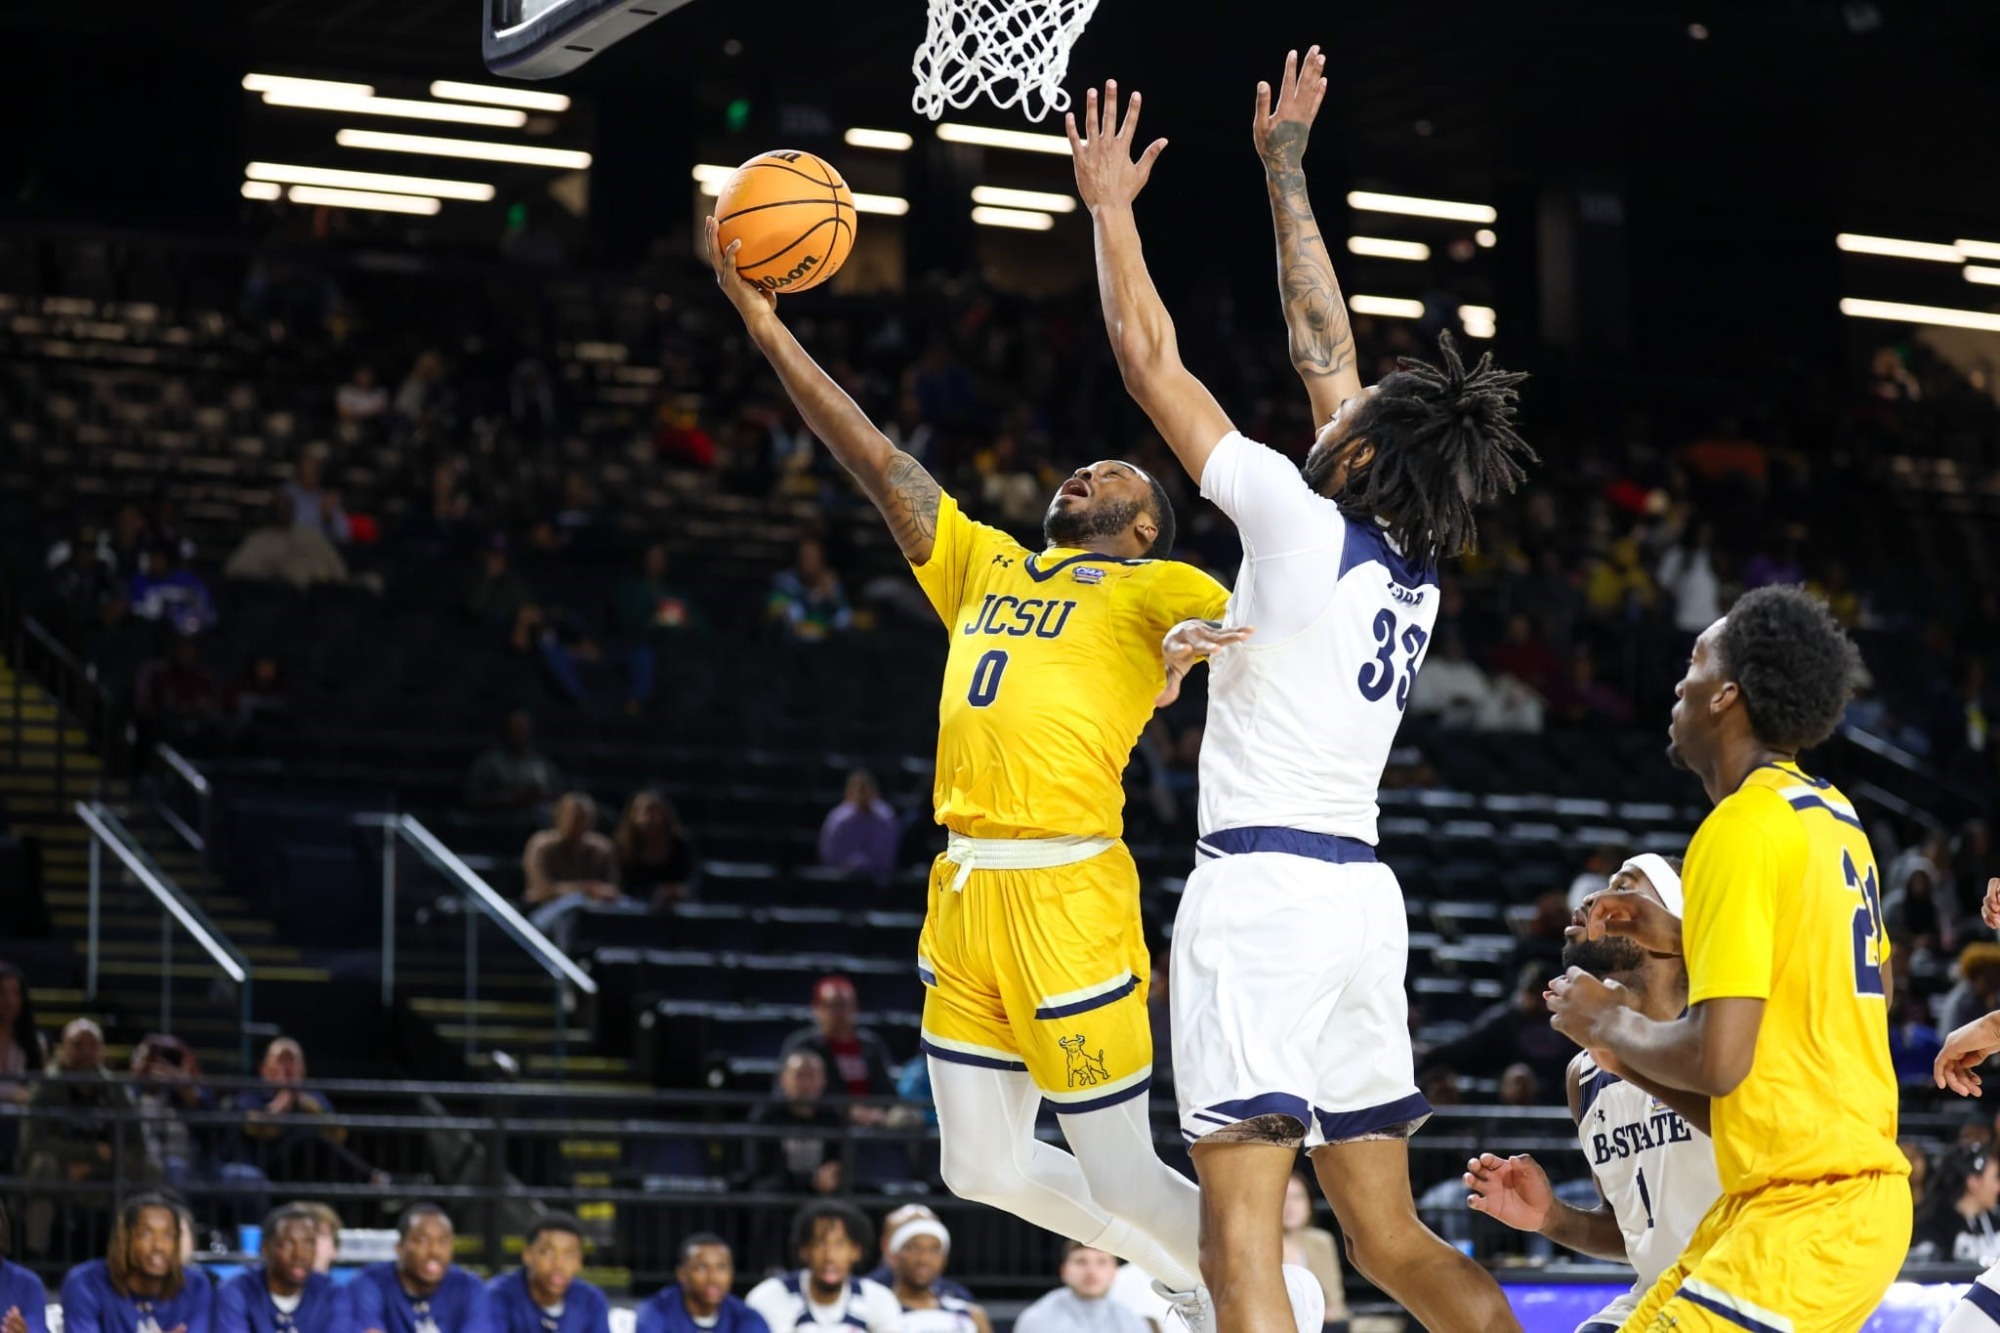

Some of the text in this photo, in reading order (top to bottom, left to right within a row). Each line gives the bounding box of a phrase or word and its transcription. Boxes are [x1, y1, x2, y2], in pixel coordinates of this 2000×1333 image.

[750, 254, 819, 290] ilson
[964, 594, 1077, 638] JCSU
[967, 649, 1009, 707] 0
[1358, 607, 1427, 711] 33
[1593, 1111, 1692, 1165] B-STATE
[1636, 1166, 1654, 1229] 1
